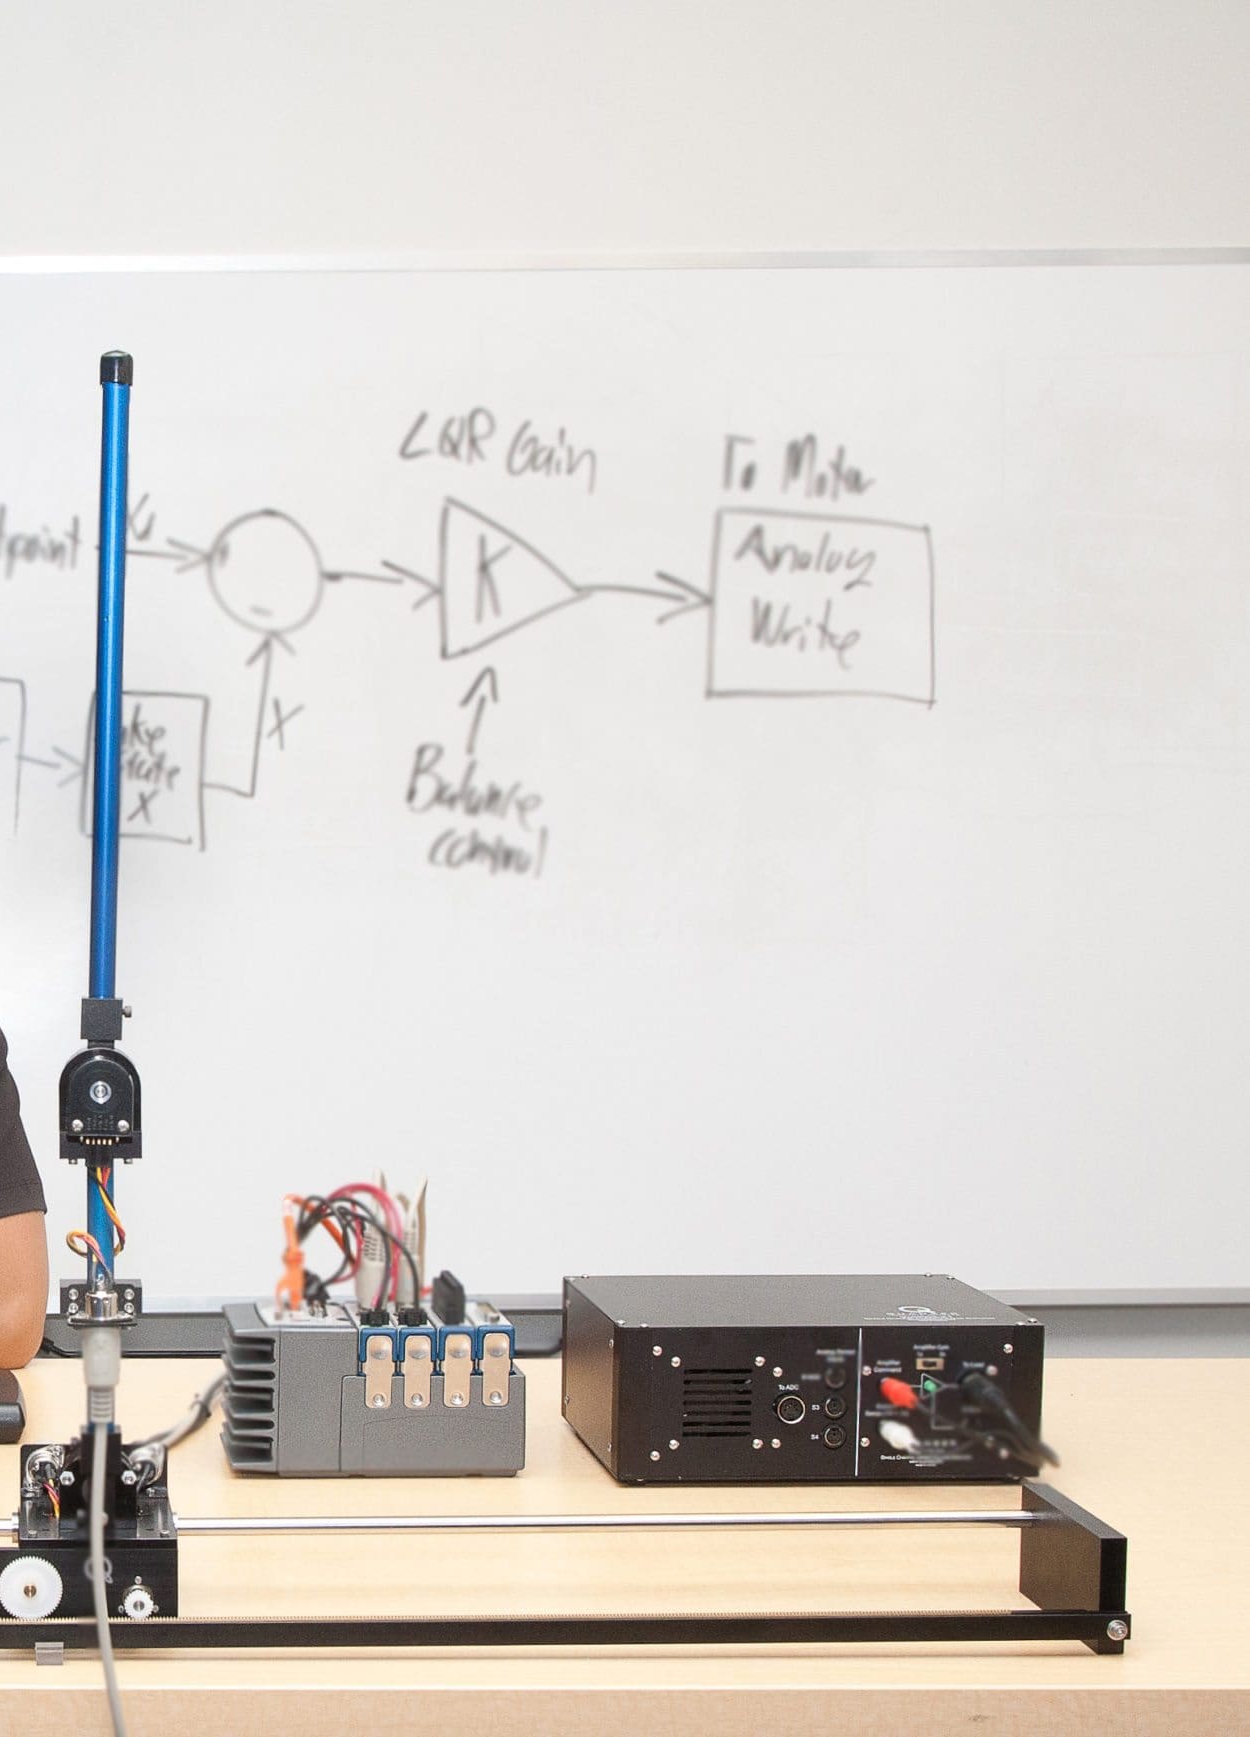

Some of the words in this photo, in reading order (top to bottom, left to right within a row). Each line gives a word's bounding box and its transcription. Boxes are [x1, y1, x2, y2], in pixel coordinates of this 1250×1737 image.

[398, 406, 497, 465] LQR
[506, 419, 598, 495] Gain
[723, 433, 758, 491] To
[781, 432, 875, 502] Motor
[474, 534, 513, 625] K
[734, 524, 878, 592] Analog
[751, 597, 862, 671] Write
[122, 703, 167, 757] ke
[125, 750, 181, 791] tate
